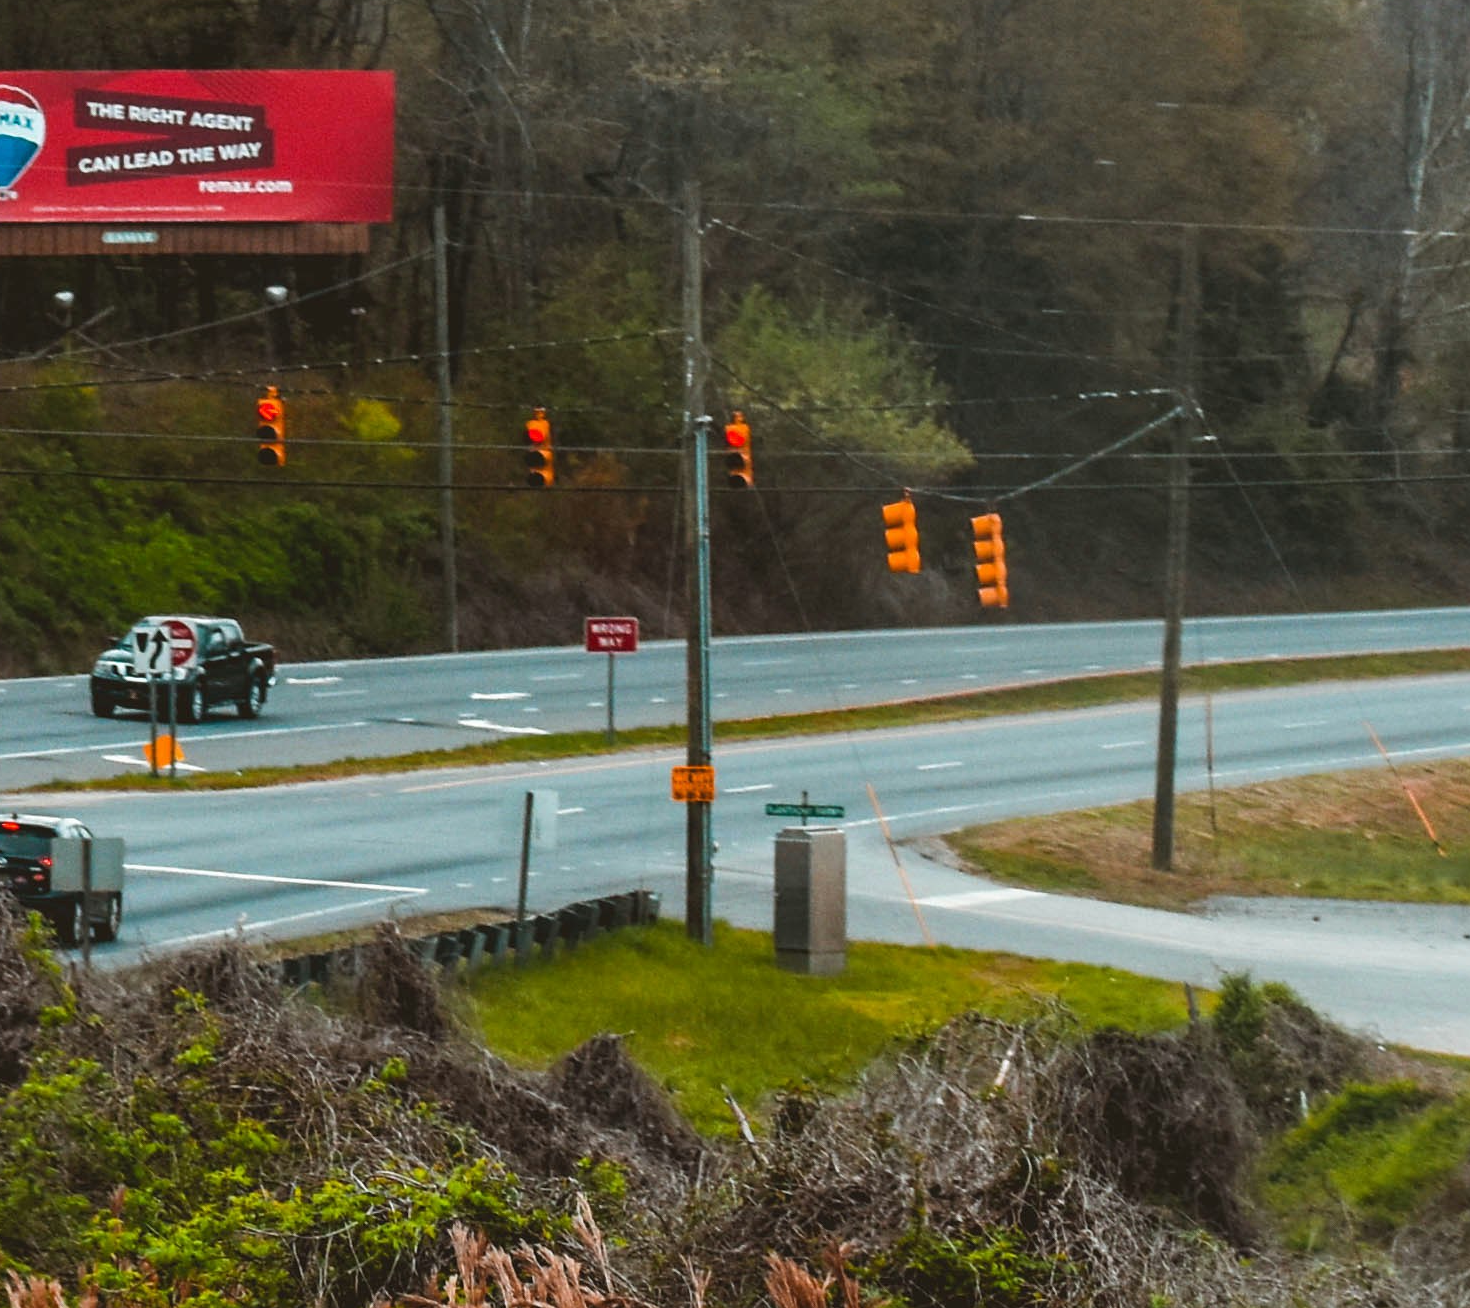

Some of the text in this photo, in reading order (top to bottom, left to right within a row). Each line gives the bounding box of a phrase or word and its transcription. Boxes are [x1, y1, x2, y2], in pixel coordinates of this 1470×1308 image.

[87, 101, 254, 131] THE RIGHT AGENT
[78, 142, 262, 174] CAN LEAD THE WAY
[198, 179, 293, 193] remax.com
[591, 624, 632, 634] WRONG
[599, 637, 623, 647] WAY
